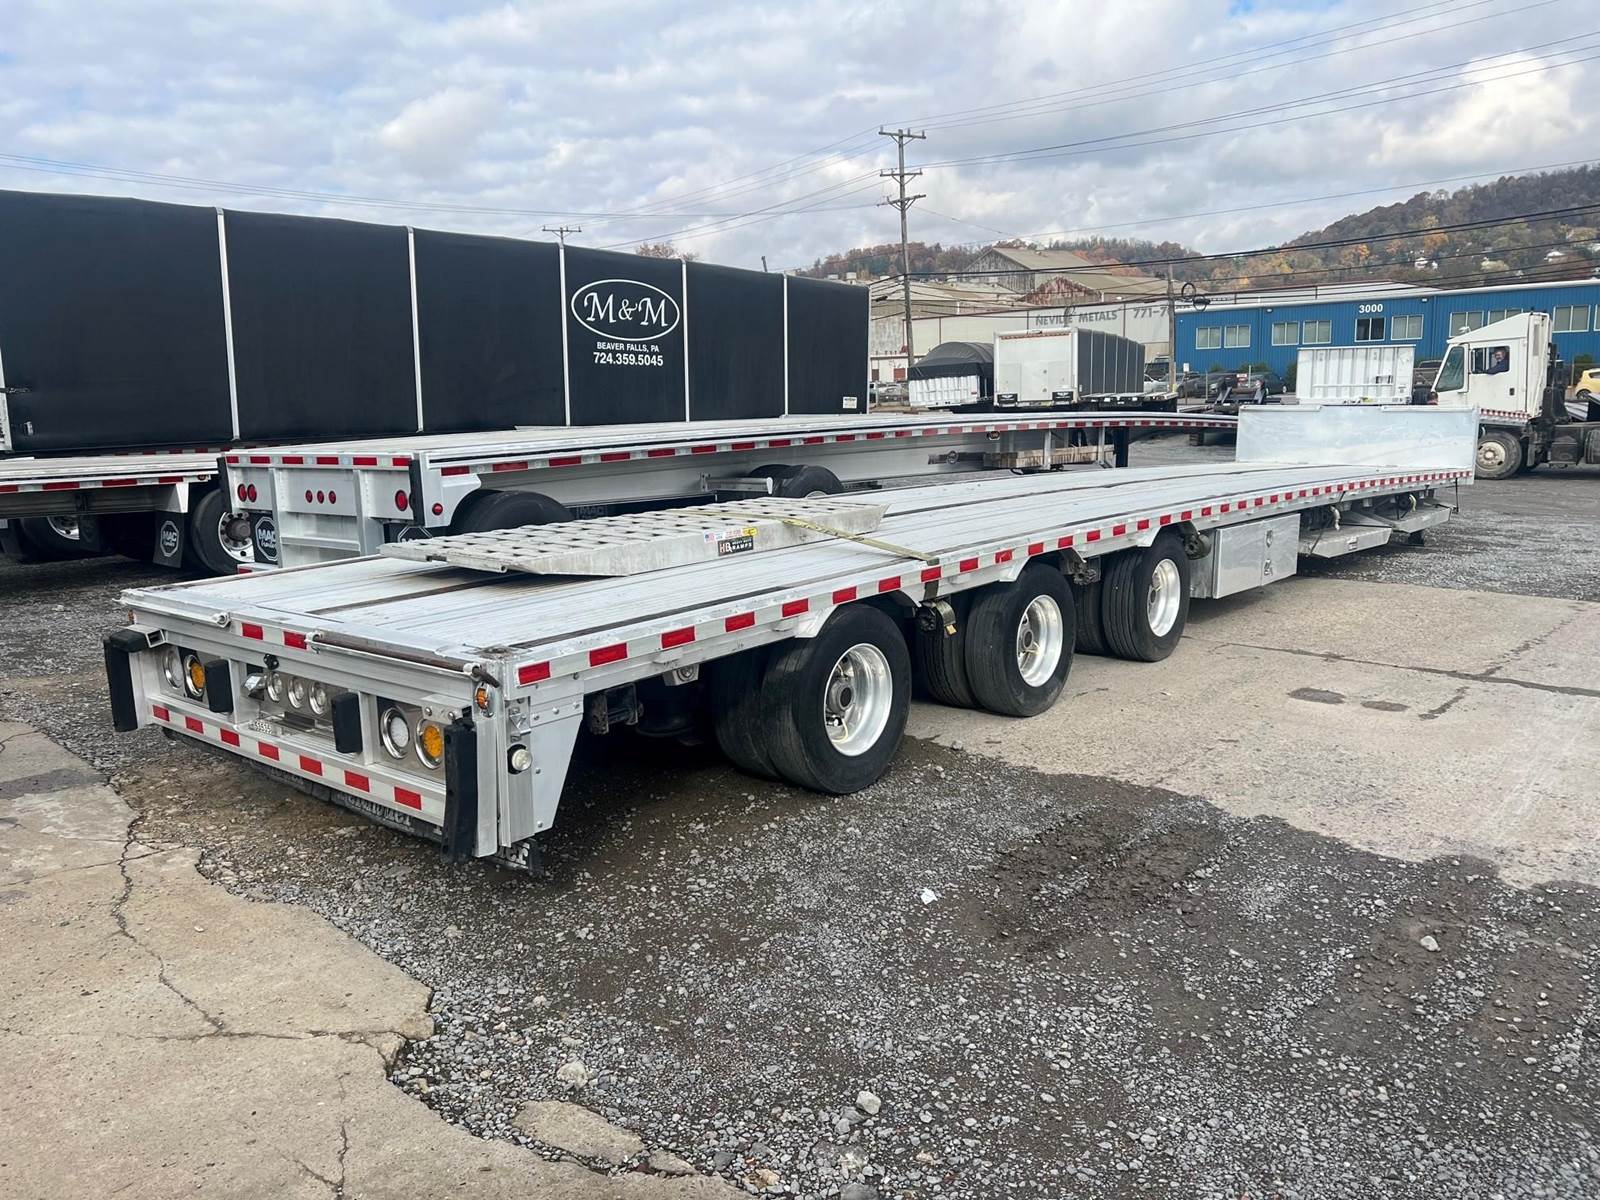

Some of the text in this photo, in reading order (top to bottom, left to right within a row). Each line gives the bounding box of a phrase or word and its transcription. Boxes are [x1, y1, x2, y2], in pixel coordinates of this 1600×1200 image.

[584, 292, 668, 327] M&M
[1078, 310, 1118, 323] METALS
[1133, 306, 1170, 318] 771-7
[1358, 303, 1384, 314] 3000
[597, 342, 660, 353] BEAVER FALLS, PA
[593, 352, 664, 366] 724.359.5045
